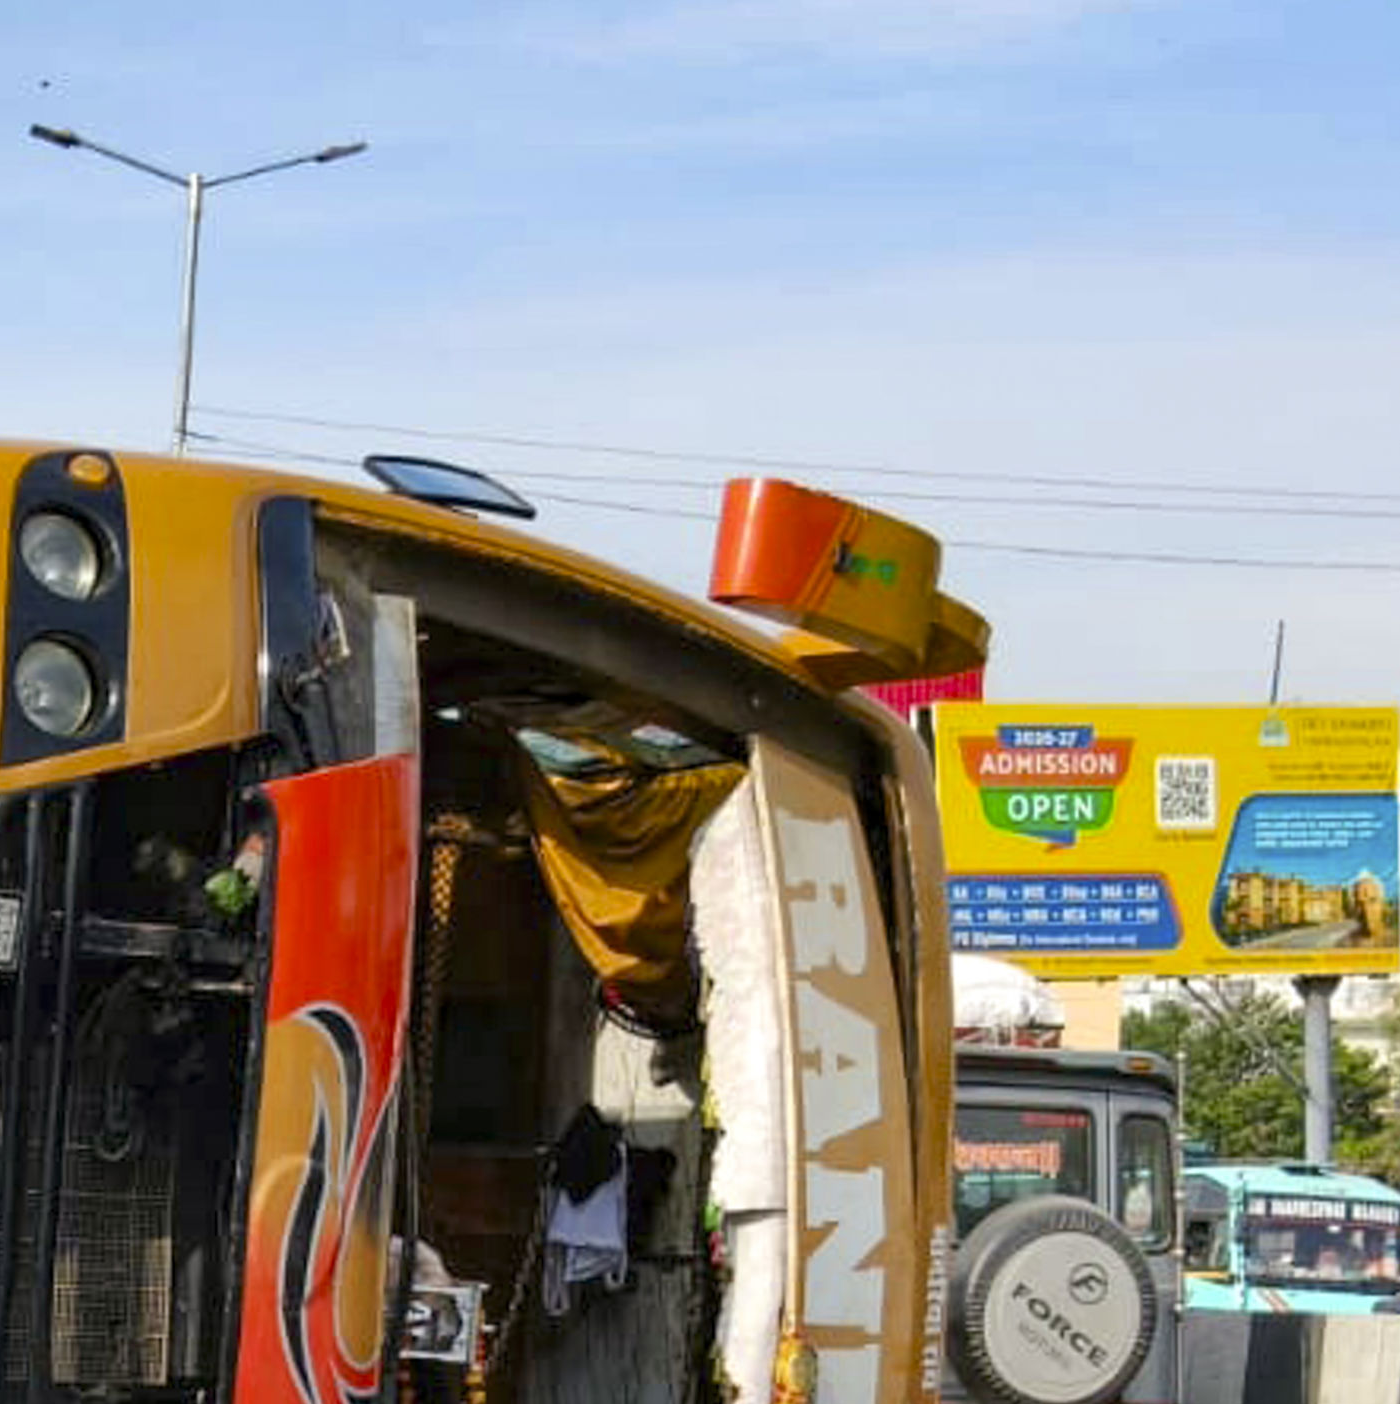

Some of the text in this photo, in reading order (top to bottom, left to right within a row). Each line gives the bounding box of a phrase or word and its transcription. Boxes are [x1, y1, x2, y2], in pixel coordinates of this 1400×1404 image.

[979, 753, 1117, 775] ADMISSION
[1007, 794, 1093, 822] OPEN
[1012, 1281, 1108, 1369] FORCE
